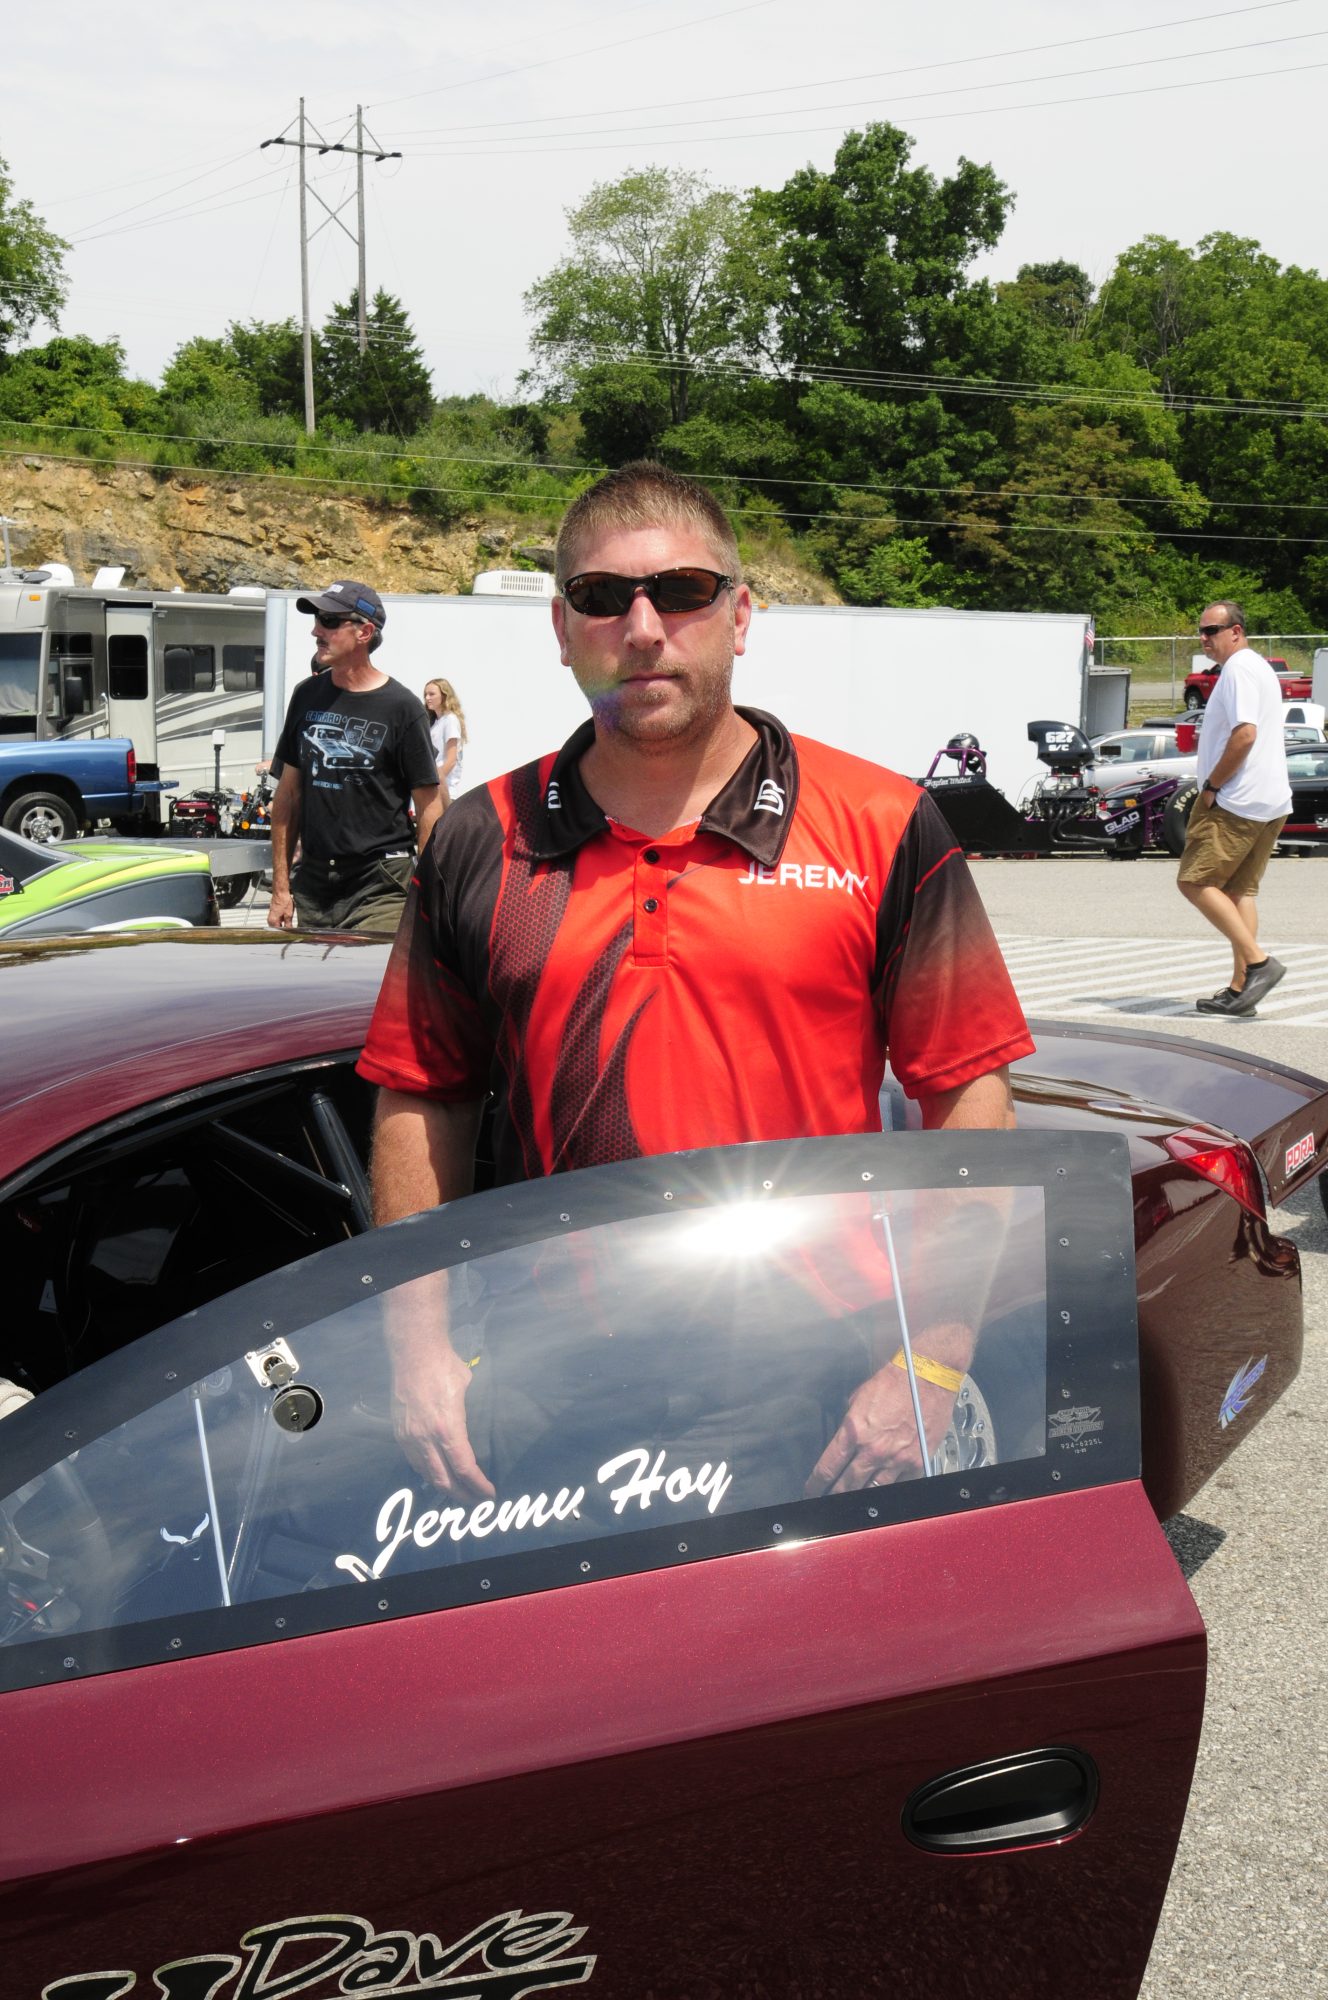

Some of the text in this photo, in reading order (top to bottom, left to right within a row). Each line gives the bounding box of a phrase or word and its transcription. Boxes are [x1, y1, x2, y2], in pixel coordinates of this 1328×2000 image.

[1045, 731, 1075, 743] 627
[1104, 811, 1140, 833] GLAD
[738, 860, 869, 896] JEREMY
[1286, 1132, 1315, 1174] PDRA
[597, 1448, 732, 1514] Hoy
[233, 1909, 590, 2000] Dave
